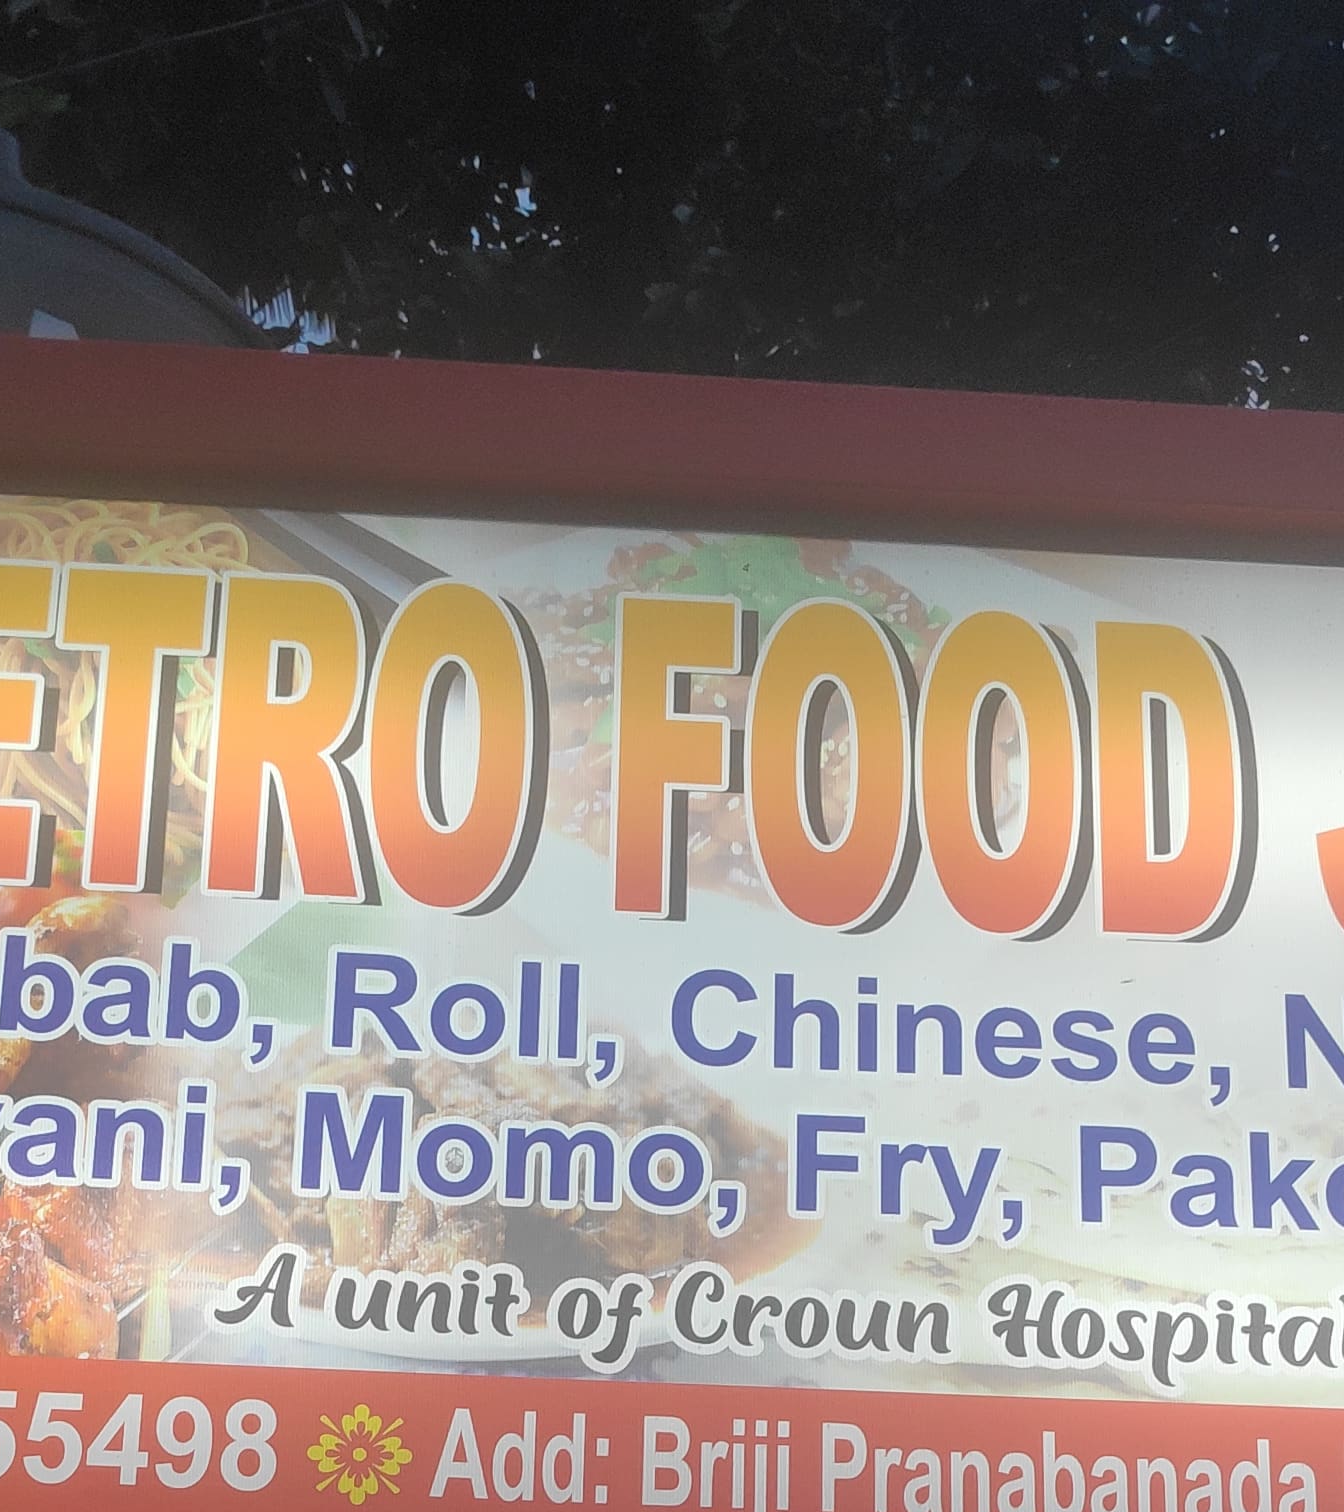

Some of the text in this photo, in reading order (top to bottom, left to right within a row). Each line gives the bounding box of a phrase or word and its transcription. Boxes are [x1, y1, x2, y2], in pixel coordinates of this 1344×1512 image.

[611, 595, 1258, 942] FOOD
[331, 951, 616, 1081] Roll,
[671, 969, 1231, 1106] Chinese,
[300, 1091, 746, 1229] Momo,
[795, 1114, 1023, 1245] Fry,
[214, 1252, 293, 1329] A
[333, 1269, 521, 1338] unit
[556, 1281, 643, 1364] of
[674, 1266, 952, 1355] Croun
[430, 1407, 611, 1505] Add:
